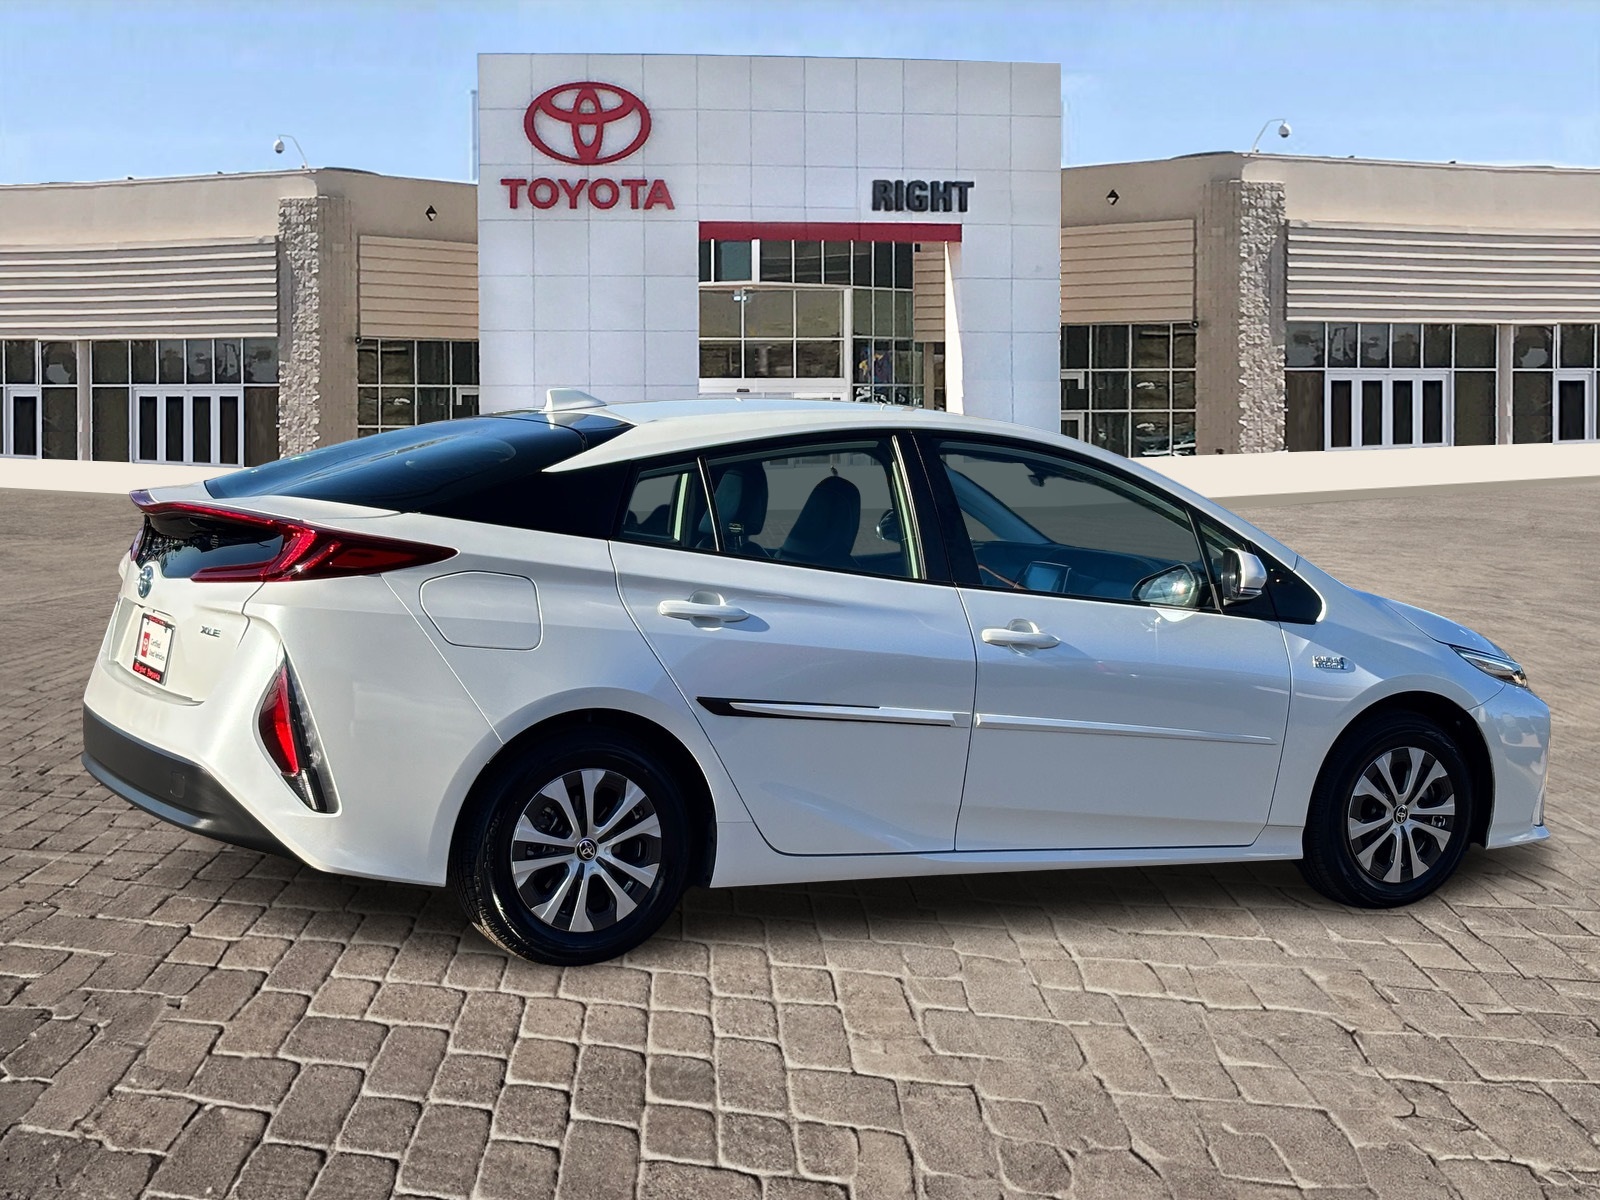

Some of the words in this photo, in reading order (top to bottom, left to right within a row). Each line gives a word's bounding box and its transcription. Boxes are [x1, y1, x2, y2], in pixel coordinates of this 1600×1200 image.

[500, 177, 675, 210] TOYOTA
[871, 179, 975, 213] RIGHT
[200, 626, 221, 638] XLE
